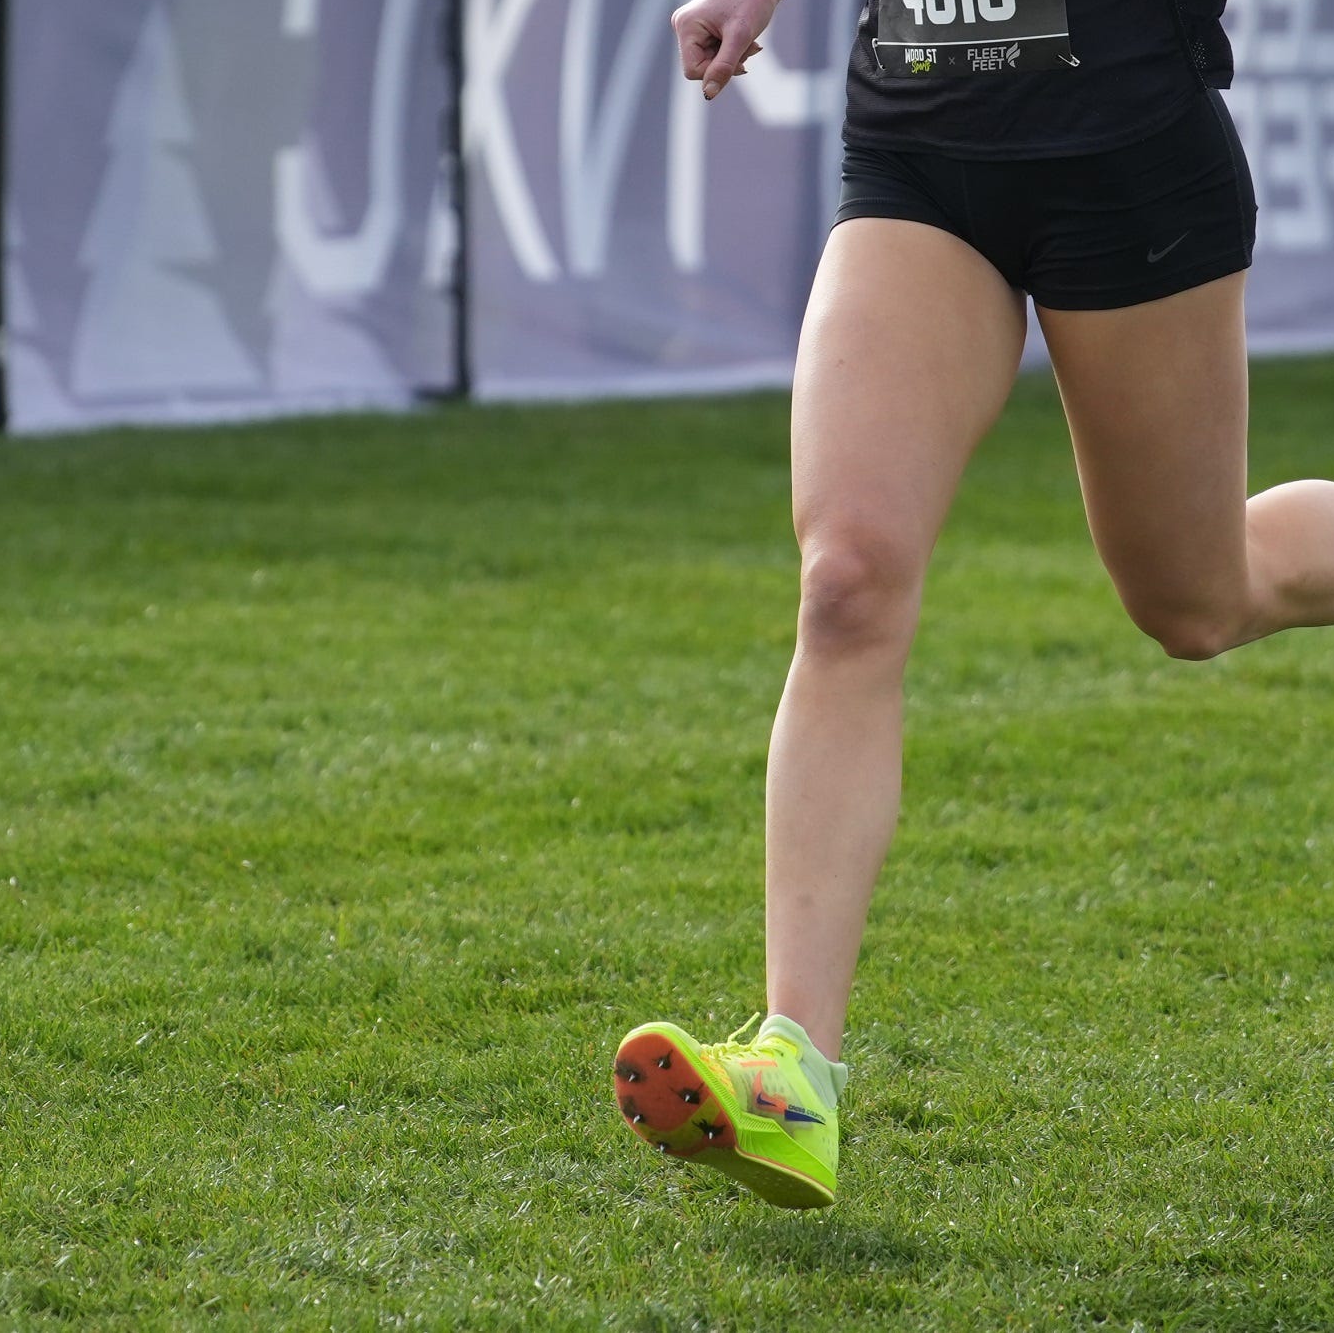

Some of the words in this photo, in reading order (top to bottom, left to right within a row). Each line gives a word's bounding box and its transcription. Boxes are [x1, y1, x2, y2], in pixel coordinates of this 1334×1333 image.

[904, 48, 924, 64] WOOD
[926, 48, 937, 64] ST
[967, 47, 1007, 61] FLEET
[972, 58, 1005, 72] FEET
